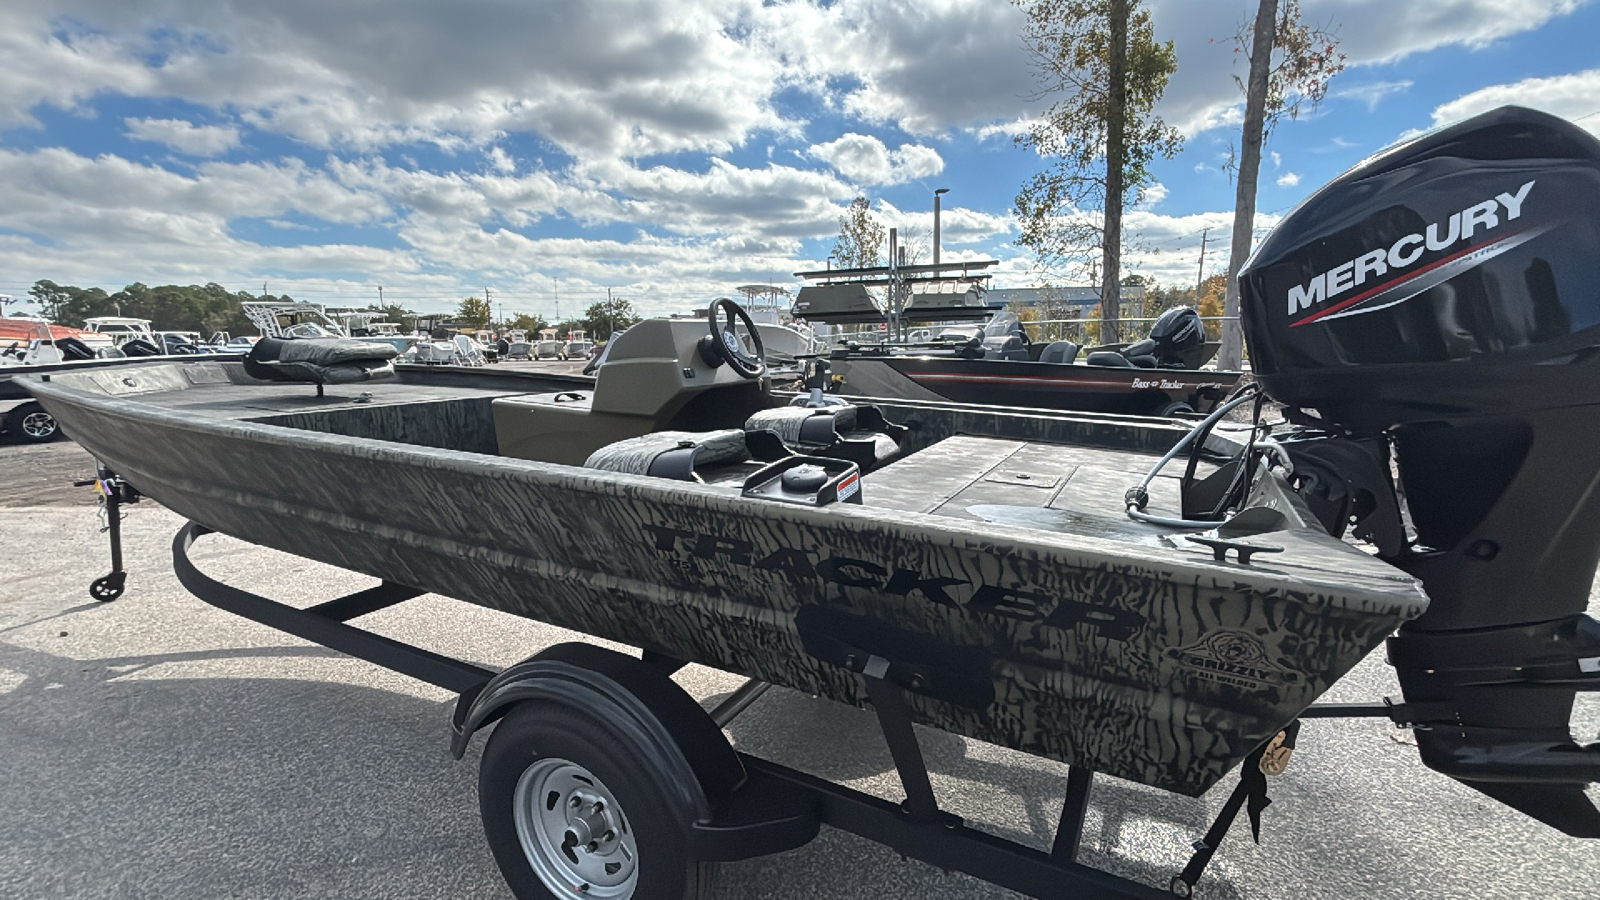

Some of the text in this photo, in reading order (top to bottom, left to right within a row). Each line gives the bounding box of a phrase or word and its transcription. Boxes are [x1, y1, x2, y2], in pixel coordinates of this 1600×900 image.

[1287, 180, 1536, 315] MERCURY
[1131, 378, 1150, 389] Bass
[1159, 379, 1185, 389] Tracker
[642, 523, 1147, 641] TRACKER
[1190, 656, 1271, 680] GRIZZLY
[1216, 675, 1257, 690] WELDED
